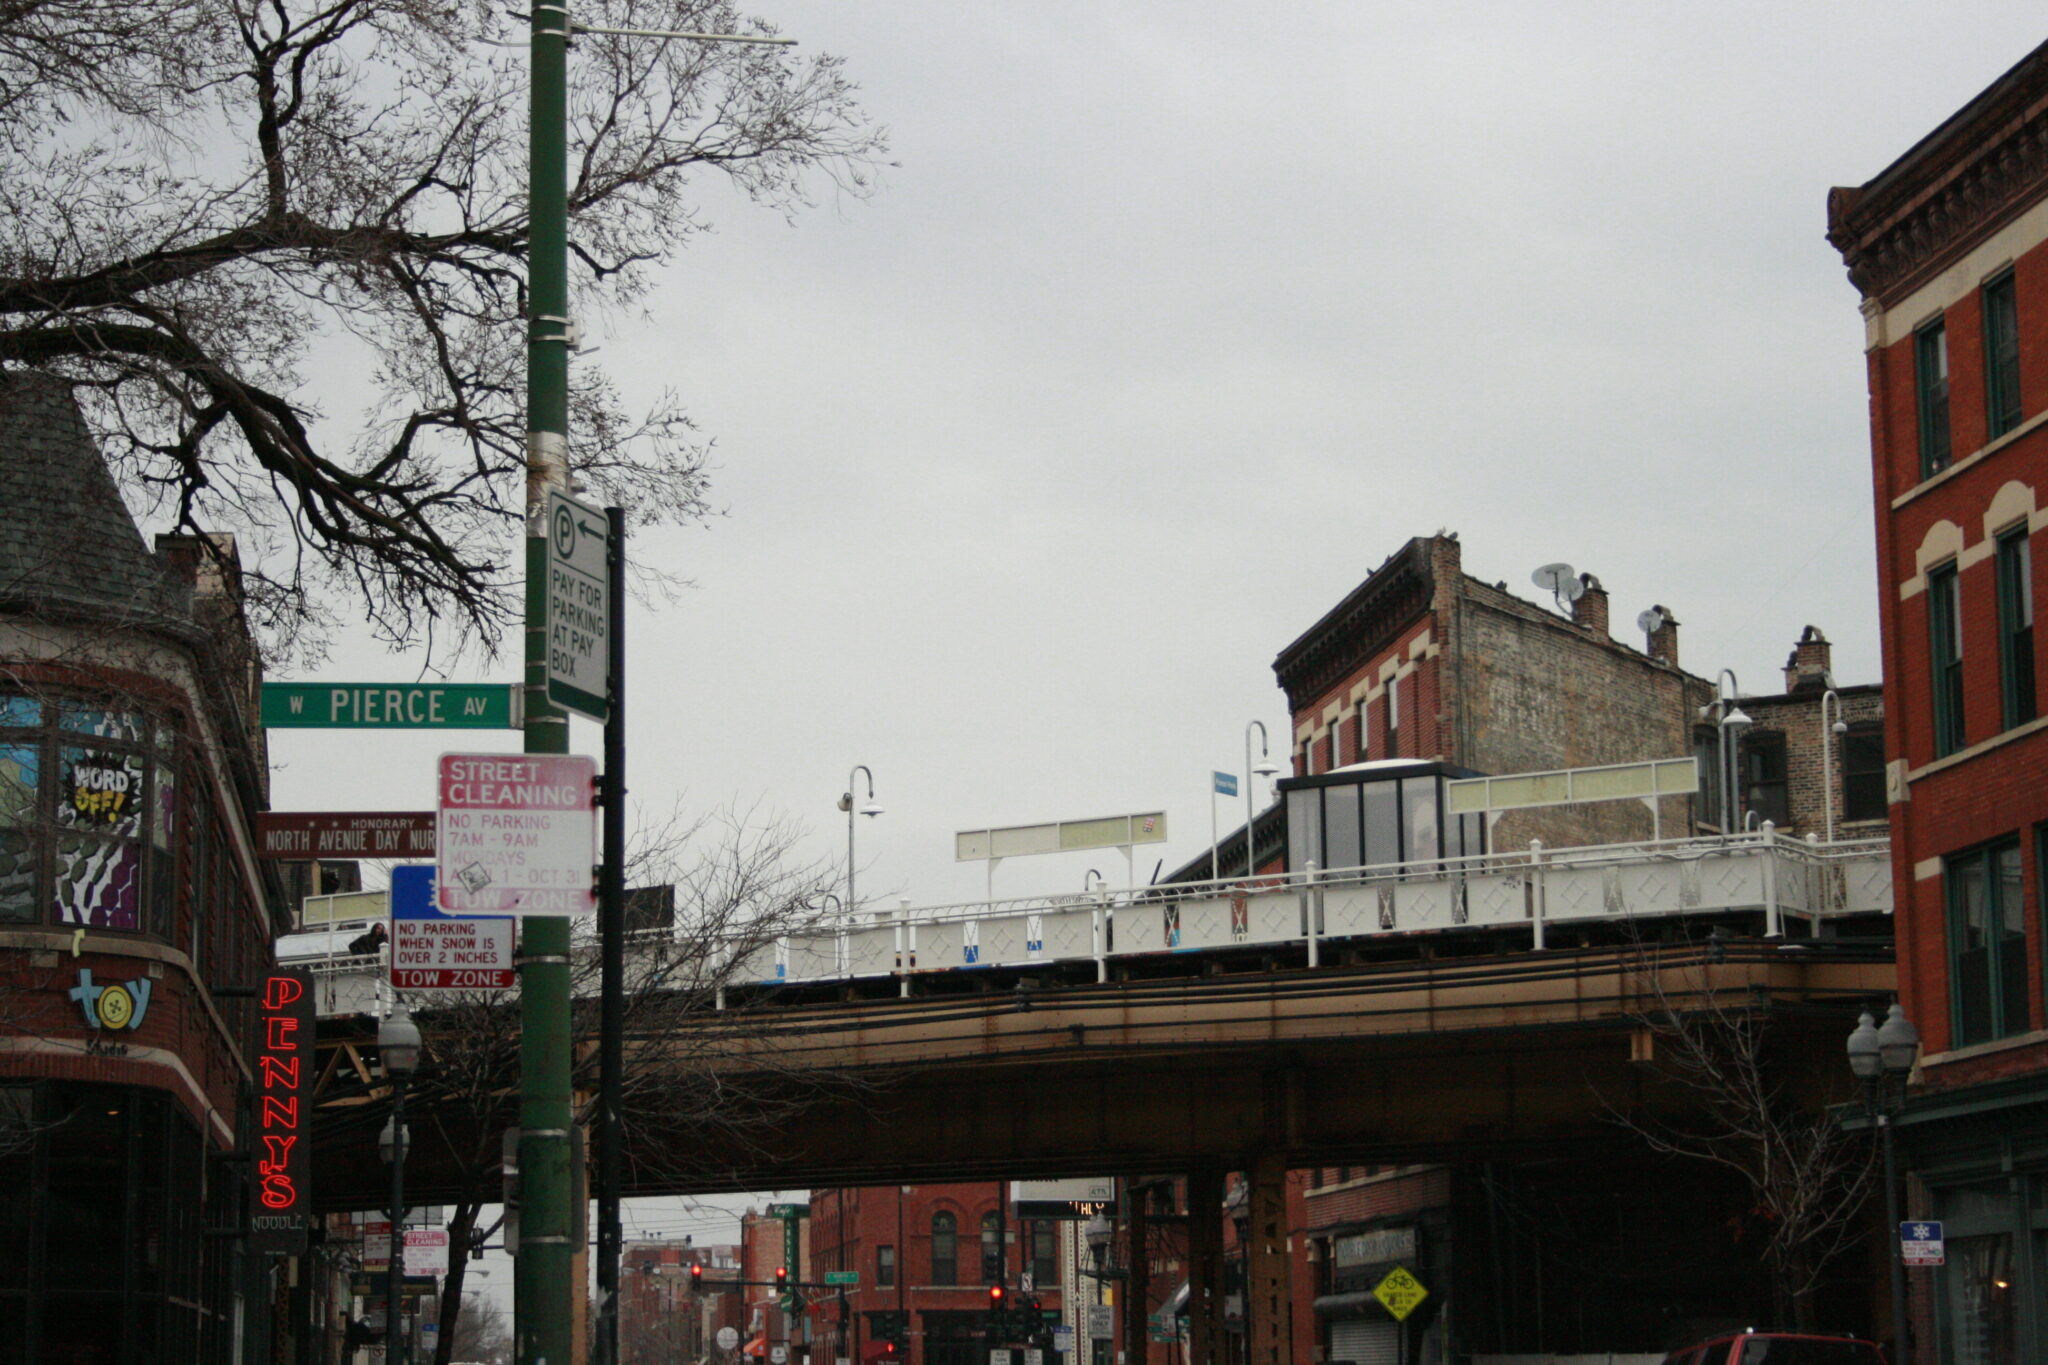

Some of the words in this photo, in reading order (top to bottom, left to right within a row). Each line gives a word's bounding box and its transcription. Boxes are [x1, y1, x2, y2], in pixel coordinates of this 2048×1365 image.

[552, 569, 575, 595] PAY
[579, 581, 602, 611] FOR
[552, 596, 605, 638] PARKING
[553, 623, 567, 645] AT
[571, 630, 594, 658] PAY
[552, 649, 576, 678] BOX
[290, 696, 303, 715] W
[331, 689, 445, 723] PIERCE
[463, 697, 487, 716] AV
[74, 765, 129, 793] WORD
[451, 761, 540, 782] STREET
[74, 787, 127, 823] OFF!
[449, 784, 577, 806] CLEANING
[351, 819, 415, 829] HONORARY
[449, 814, 471, 829] NO
[481, 814, 550, 830] PARKING
[266, 830, 310, 851] NORTH
[318, 830, 367, 850] AVENUE
[375, 830, 401, 850] DAY
[449, 832, 484, 847] 7AM
[503, 833, 538, 848] 9AM
[529, 869, 554, 884] OCT
[566, 869, 581, 884] 31
[450, 891, 500, 908] TOW
[517, 891, 582, 910] ZONE
[398, 923, 416, 935] NO
[423, 923, 476, 935] PARKING
[399, 938, 434, 950] WHEN
[442, 938, 476, 949] SNOW
[483, 938, 494, 949] IS
[398, 952, 431, 964] OVER
[438, 952, 447, 964] 2
[454, 952, 498, 964] INCHES
[399, 971, 440, 986] TOW
[451, 971, 503, 986] ZONE
[68, 968, 152, 1030] toy
